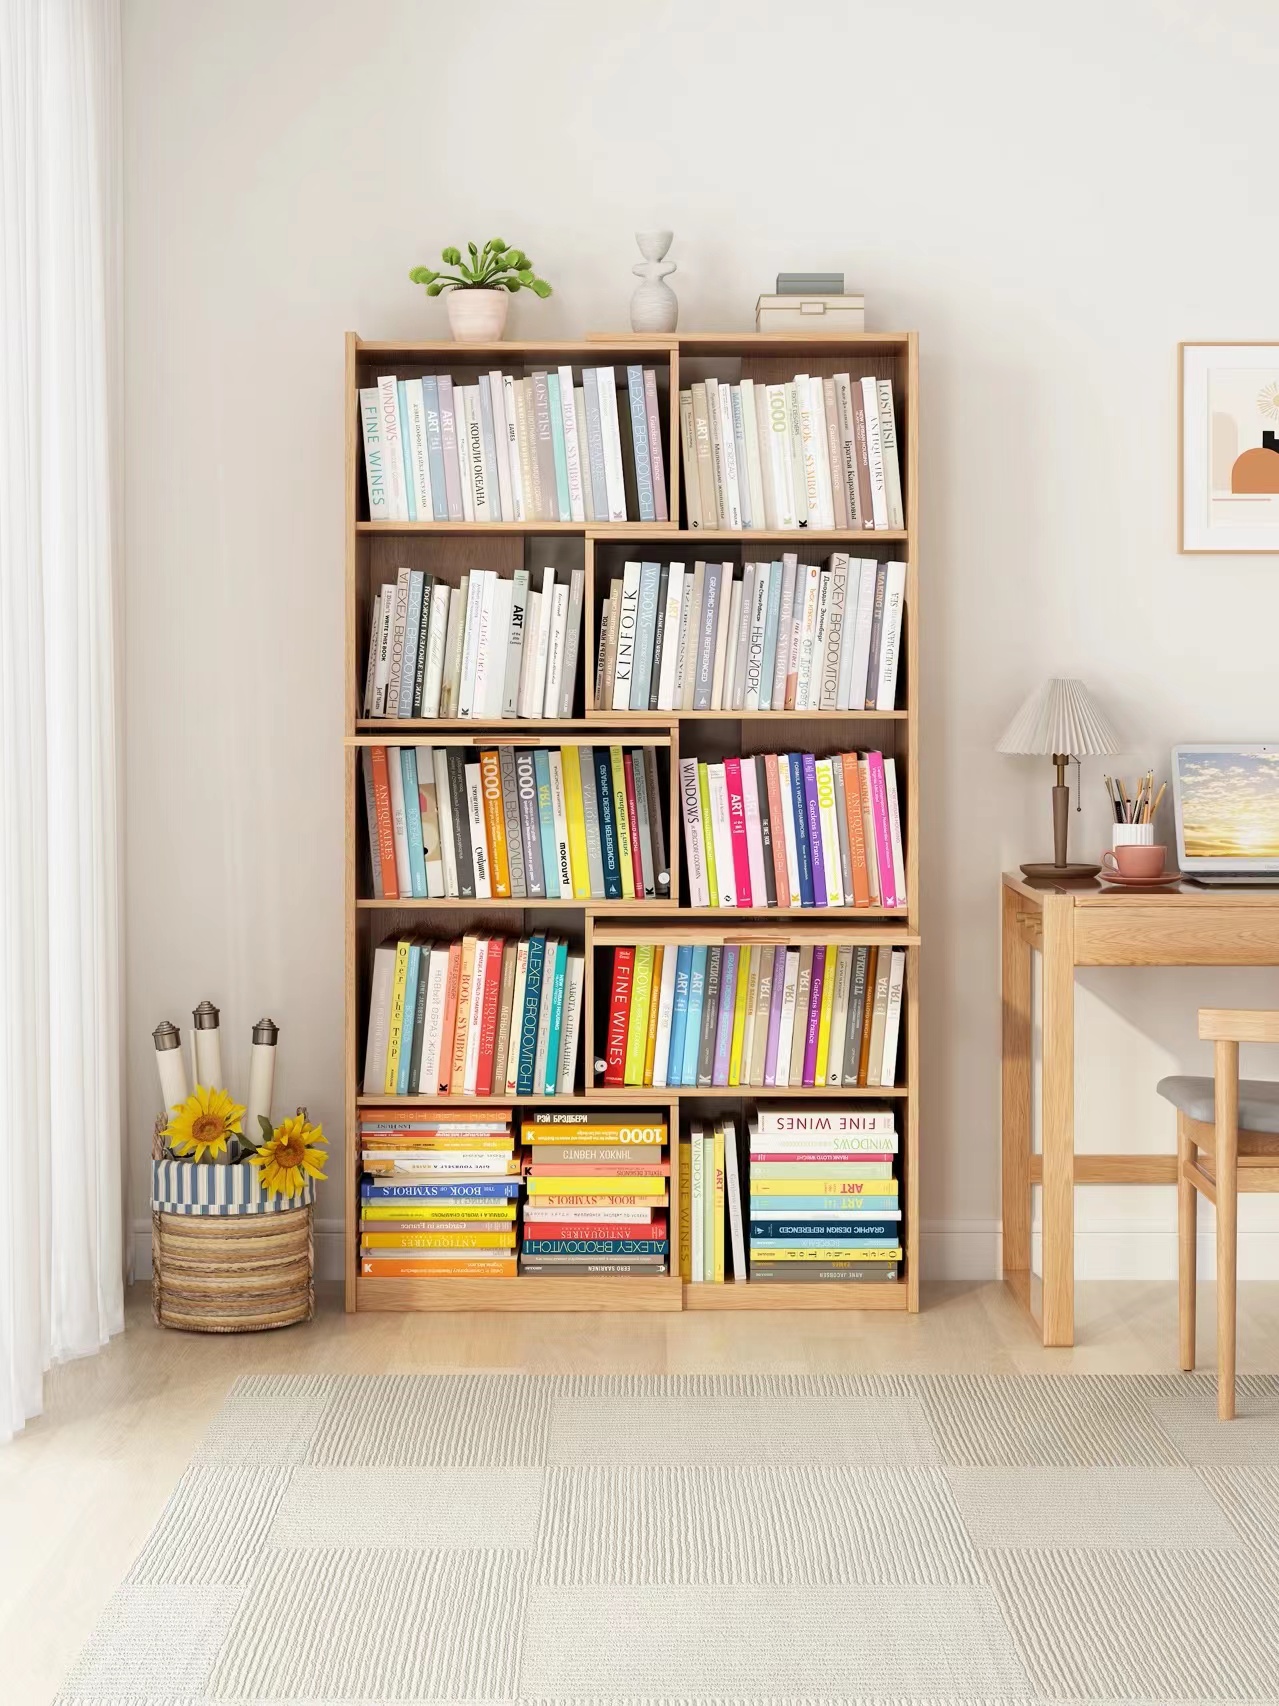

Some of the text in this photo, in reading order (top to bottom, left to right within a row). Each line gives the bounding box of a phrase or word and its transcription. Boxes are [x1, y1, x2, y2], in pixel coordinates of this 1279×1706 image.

[535, 376, 547, 408] LOST
[382, 380, 397, 441] WINDOWS
[428, 411, 439, 433] ART
[442, 410, 454, 433] ART
[538, 412, 550, 440] FISH
[732, 393, 741, 429] MAKING
[770, 391, 786, 433] 1000
[880, 384, 894, 449] LOST FISH
[470, 422, 481, 463] КОРОЛИ
[630, 370, 651, 512] ALEXEY BRODOVITCH
[696, 418, 708, 440] ART
[365, 406, 384, 506] FINE WINES
[564, 403, 580, 500] BOOK SYMBOLS
[801, 411, 817, 510] BOOK SYMBOLS
[474, 465, 485, 506] ОКЕАНА
[844, 440, 857, 520] Братья Карамазовы
[640, 568, 657, 628] WINDOWS
[875, 571, 885, 607] MAKING
[512, 605, 523, 628] ART
[617, 589, 638, 680] KINFOLK
[702, 577, 716, 682] GRAPHIC DESIGN REFERENCED
[824, 557, 847, 701] ALEXEY BRODOVITCH
[402, 574, 422, 709] ALEXEY BRODOVITCH
[747, 626, 763, 694] НЬЮ-ЙОРК
[817, 765, 834, 808] 1000
[380, 784, 393, 860] ANTIQUAIRES
[731, 794, 742, 816] ART
[812, 831, 818, 839] in
[853, 792, 864, 868] ANTIQUAIRES
[460, 974, 470, 1005] BOOK
[568, 981, 577, 1012] ЗАБОТА
[677, 972, 688, 995] ART
[692, 972, 703, 995] ART
[812, 979, 821, 1008] Gardens
[426, 970, 442, 1076] НОВЫЙ ОБРАЗ ЖИЗНИ
[485, 980, 498, 1055] ANTIQUAIRES
[519, 941, 542, 1085] ALEXEY BRODOVITCH
[610, 966, 630, 1065] FINE WINES
[454, 1017, 466, 1072] SYMBOLS
[808, 1019, 817, 1044] France
[536, 1114, 588, 1123] РЭЙ БРЭДБЕРИ
[619, 1128, 662, 1143] 1000
[777, 1118, 876, 1130] FINE WINES
[834, 1139, 893, 1150] WINDOWS
[383, 1187, 438, 1196] SYMBOLS
[450, 1187, 481, 1195] BOOK
[548, 1196, 636, 1204] BOOK SYMBOLS
[840, 1184, 863, 1193] ART
[840, 1199, 864, 1210] ART
[681, 1162, 689, 1261] FINE WINES
[401, 1239, 476, 1247] ANTIQUAIRES
[533, 1241, 666, 1252] ALEXEY BRODOVITCH
[560, 1231, 631, 1239] ANTIQUAIRES
